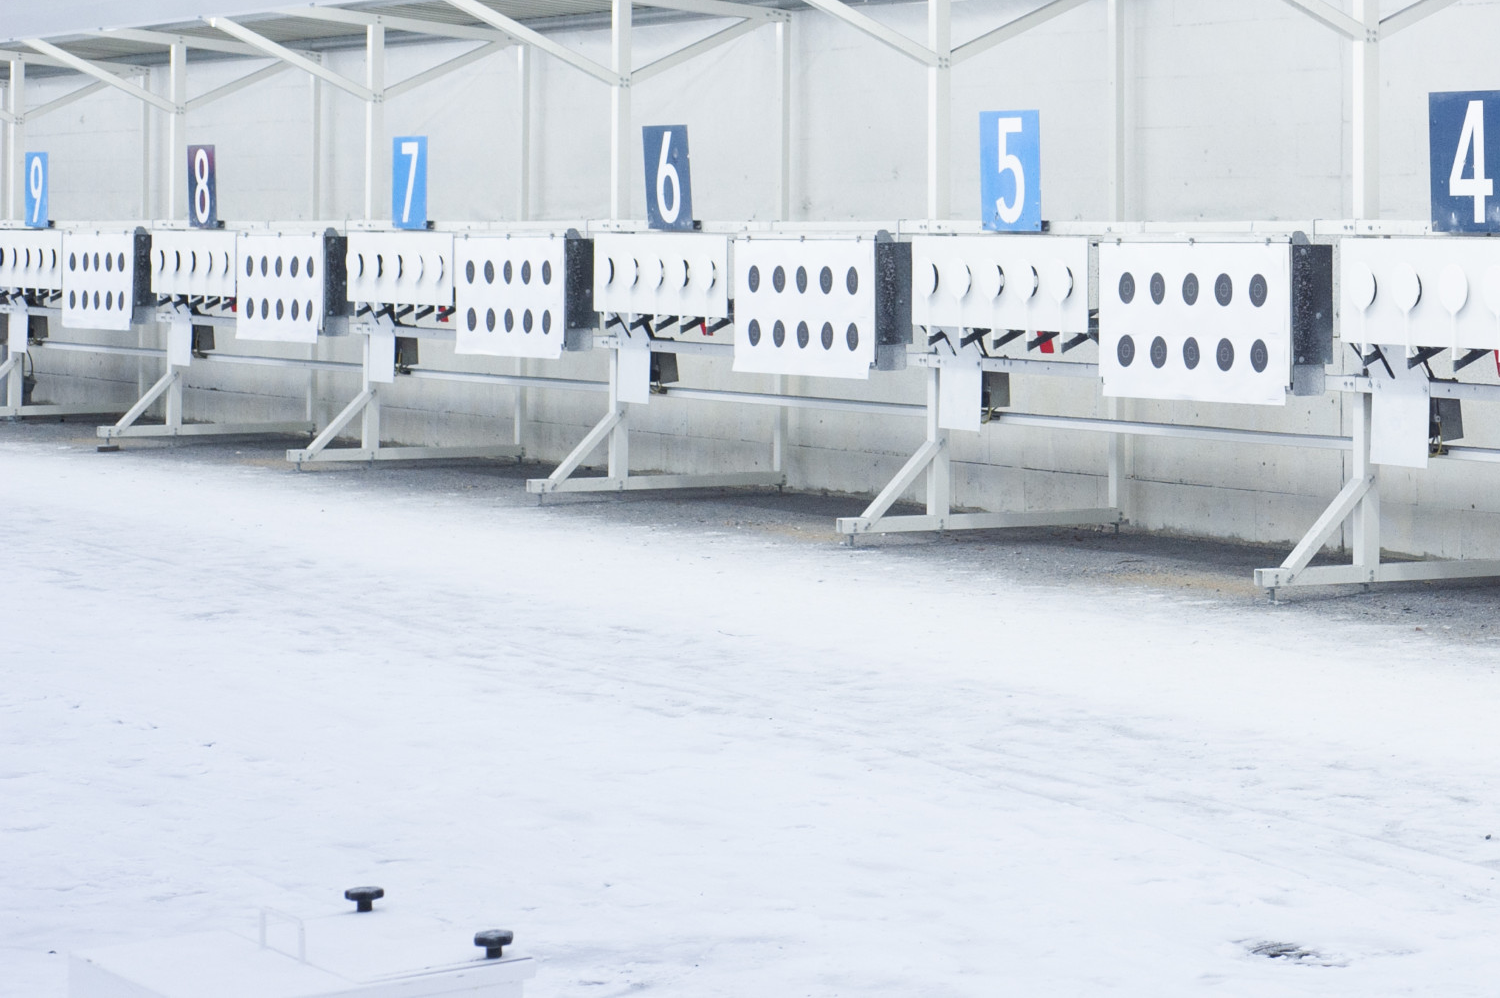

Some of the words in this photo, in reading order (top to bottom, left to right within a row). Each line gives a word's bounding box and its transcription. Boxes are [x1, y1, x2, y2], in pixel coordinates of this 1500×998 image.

[30, 156, 43, 224] 9
[194, 148, 210, 224] 8
[401, 142, 419, 223] 7
[656, 130, 681, 224] 6
[996, 116, 1026, 224] 5
[1449, 99, 1494, 224] 4
